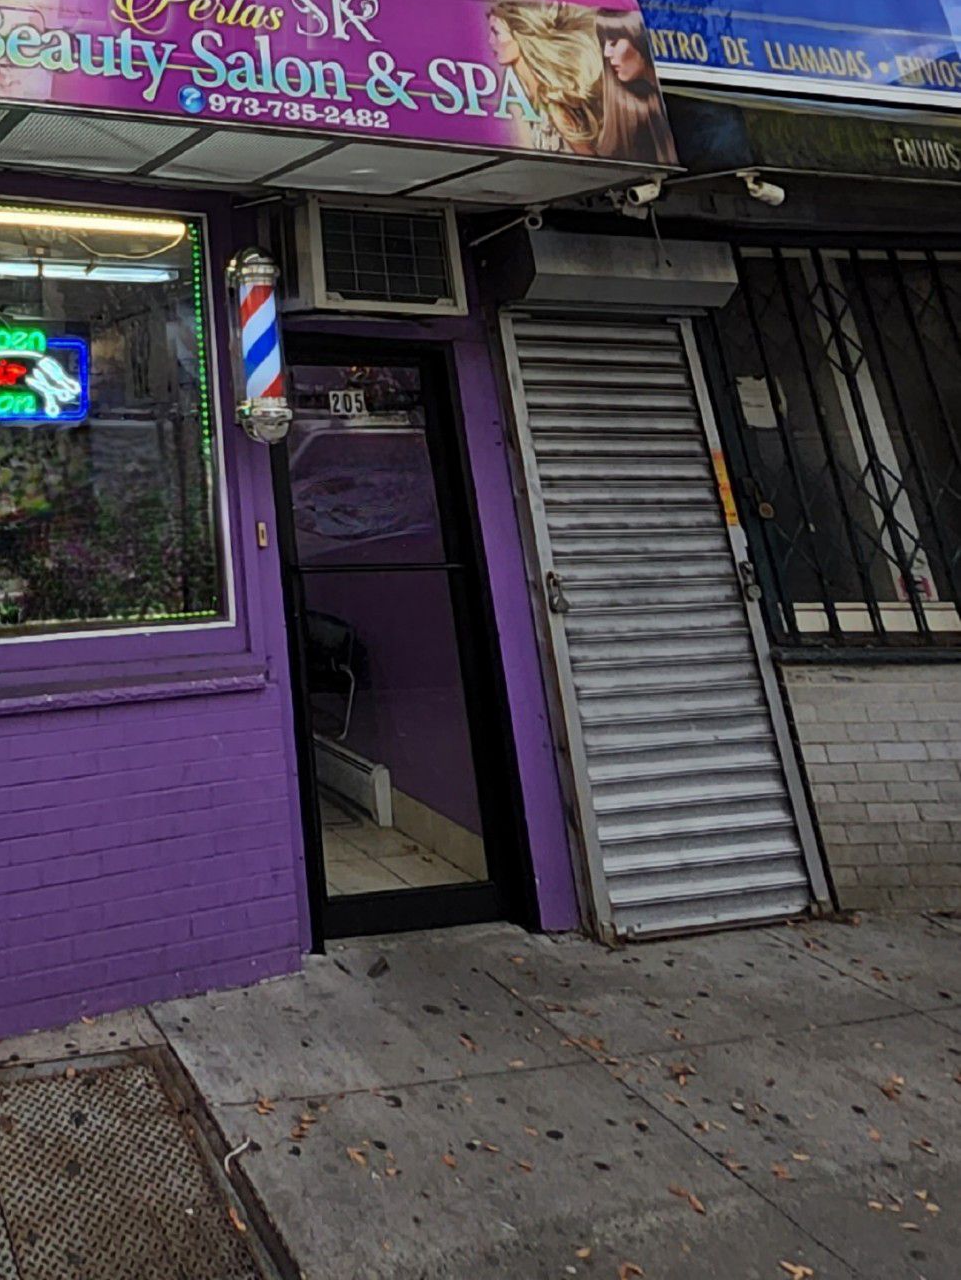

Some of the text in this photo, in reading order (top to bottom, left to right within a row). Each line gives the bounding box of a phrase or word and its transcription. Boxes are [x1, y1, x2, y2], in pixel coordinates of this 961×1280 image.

[720, 35, 754, 66] DE
[764, 40, 872, 80] LLAMADAS
[191, 29, 352, 102] Salon
[365, 51, 419, 110] &
[427, 58, 543, 123] SPA
[208, 93, 390, 129] 973-735-2482
[893, 138, 961, 170] ENVIOS
[331, 391, 366, 414] 205
